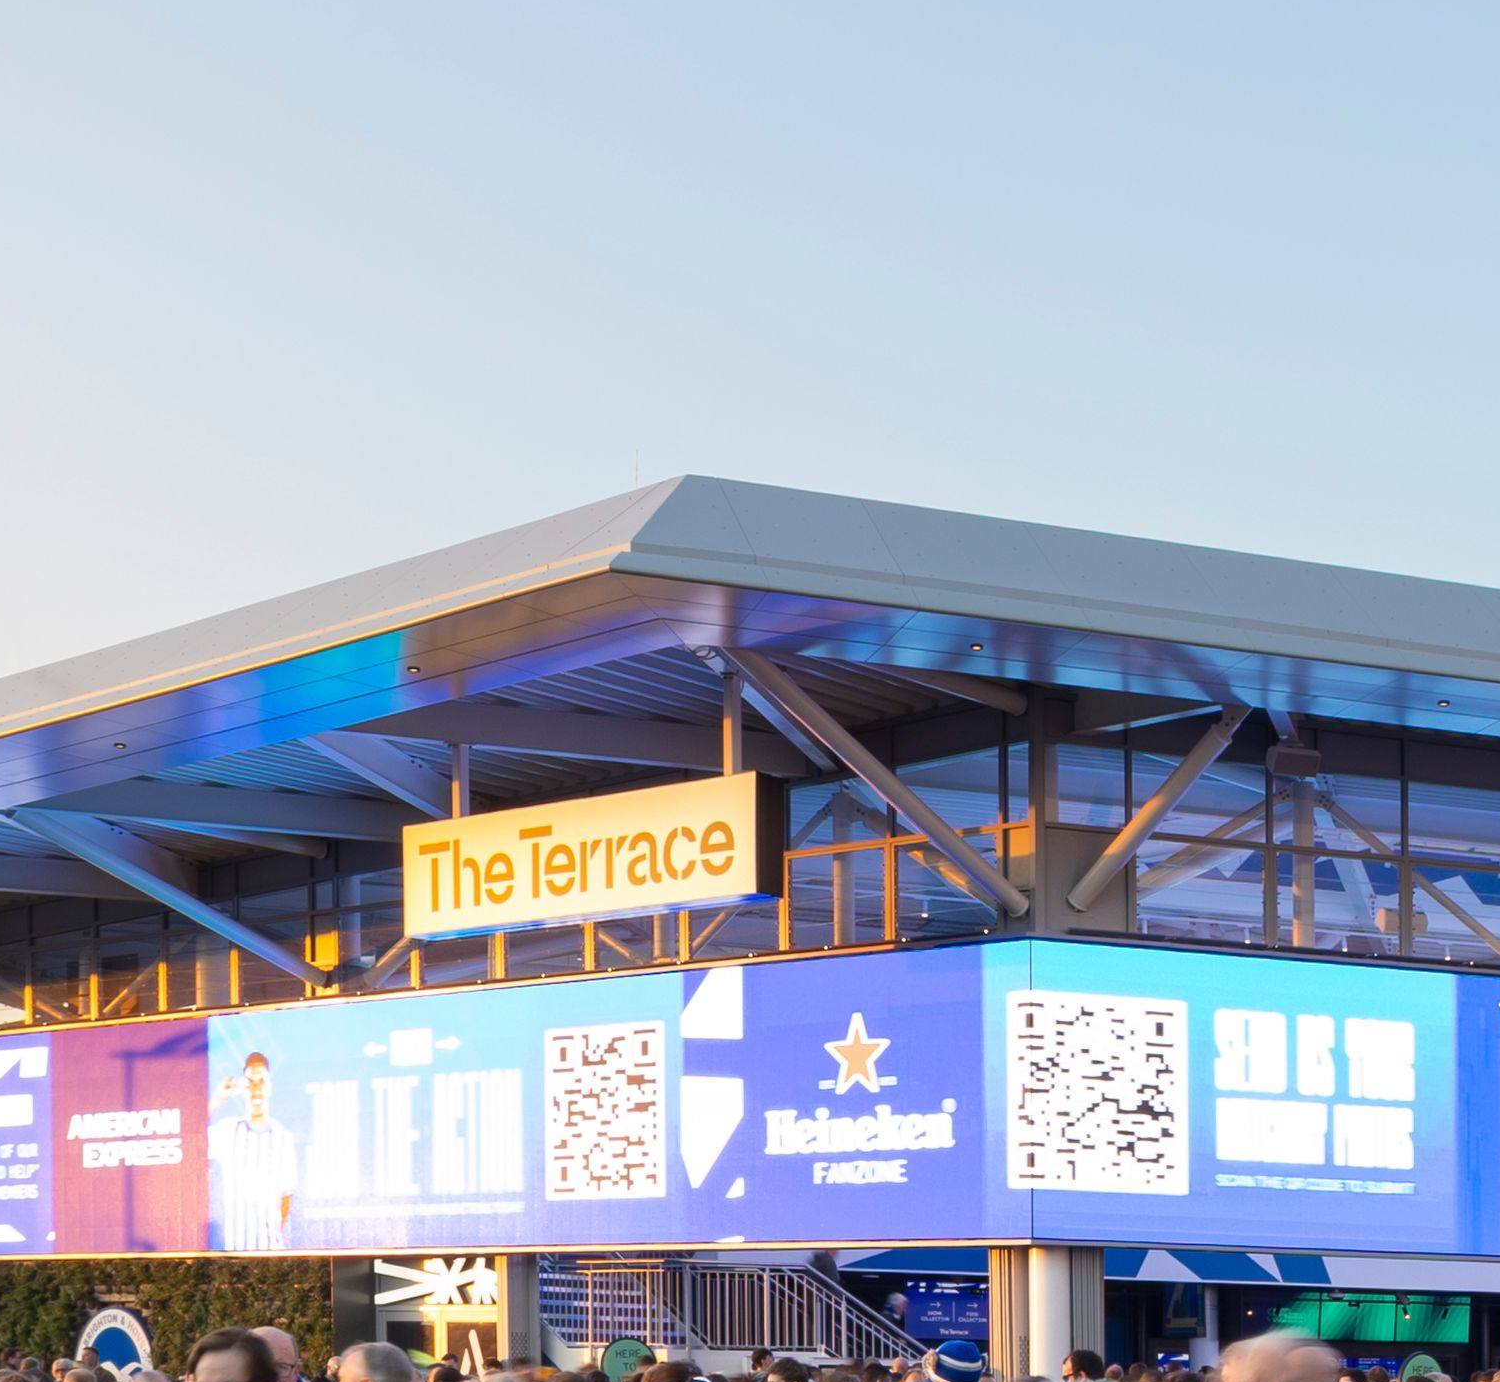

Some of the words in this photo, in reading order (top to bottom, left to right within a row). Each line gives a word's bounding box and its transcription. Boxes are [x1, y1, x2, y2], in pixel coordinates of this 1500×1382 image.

[419, 839, 515, 913] The
[519, 821, 735, 899] Terrace
[67, 1108, 182, 1141] AMERICAN
[764, 1105, 956, 1155] Heineken
[82, 1138, 183, 1169] EXPRESS
[813, 1159, 909, 1184] FANZONE
[83, 1313, 118, 1346] BRIGHTON
[120, 1316, 126, 1326] &
[615, 1348, 641, 1359] HERE
[622, 1362, 637, 1372] TO
